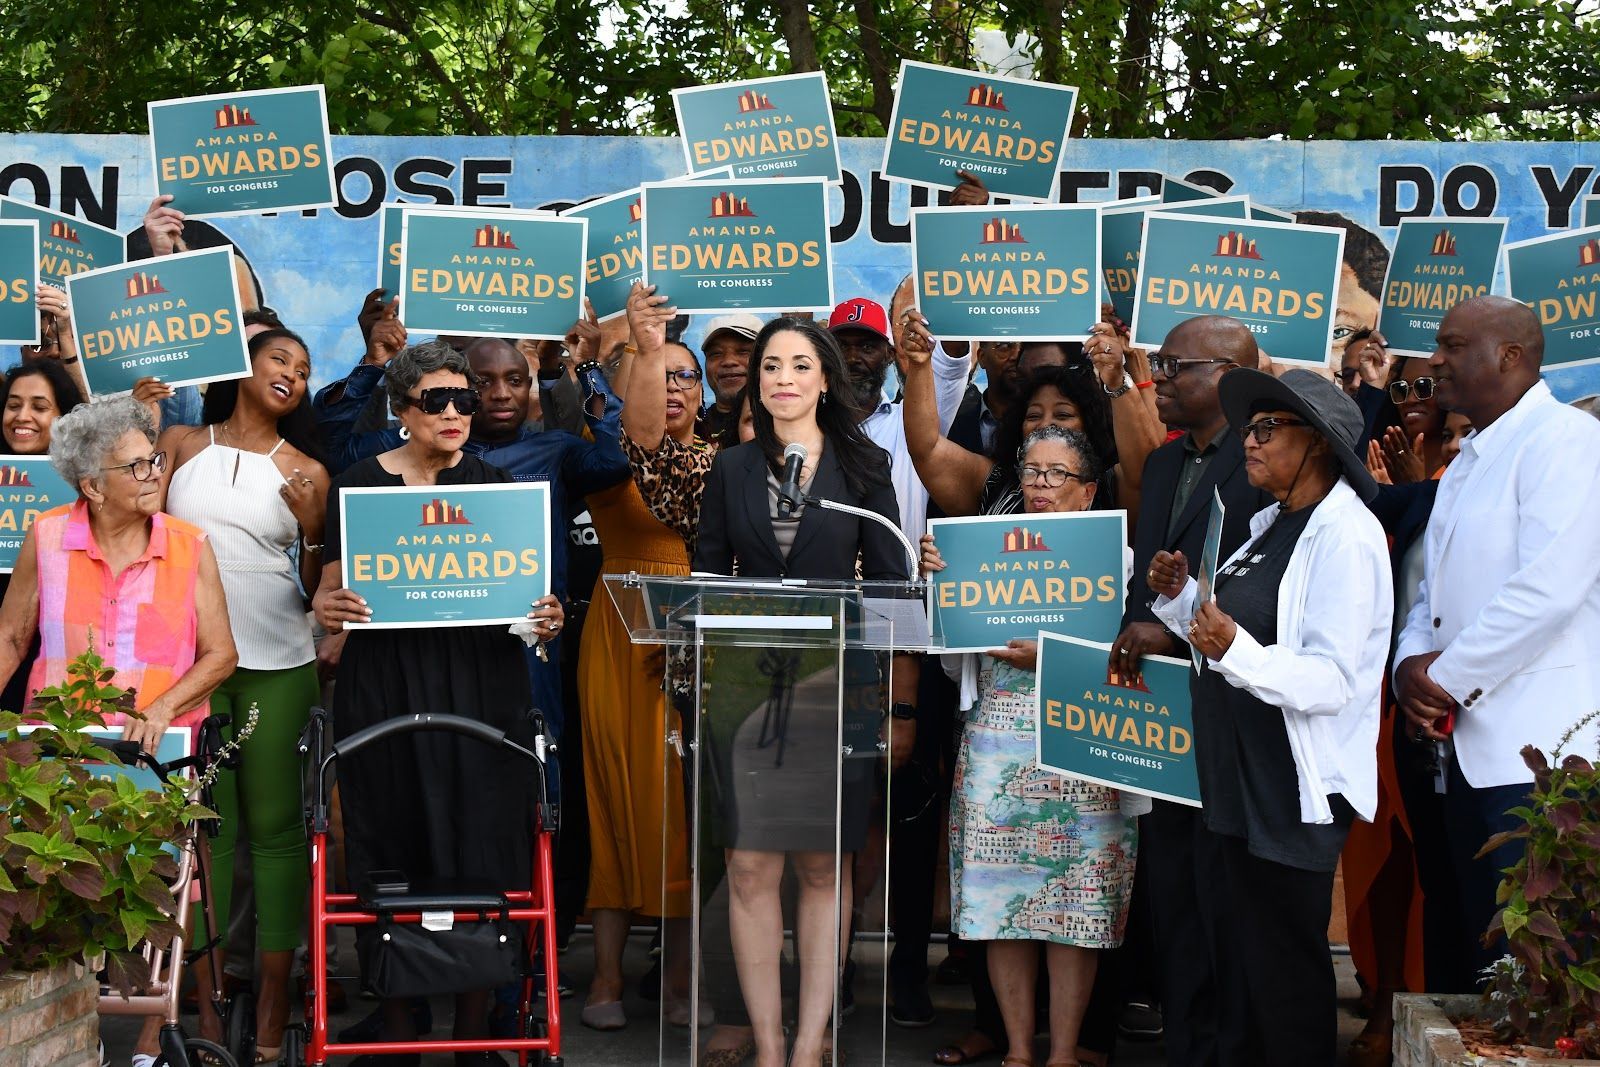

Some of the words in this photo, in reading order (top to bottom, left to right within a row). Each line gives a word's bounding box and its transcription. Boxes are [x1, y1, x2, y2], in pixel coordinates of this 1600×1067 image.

[724, 115, 793, 131] AMANDA
[940, 110, 1023, 130] AMANDA
[196, 131, 278, 147] AMANDA
[693, 125, 829, 164] EDWARDS
[899, 118, 1056, 164] EDWARDS
[161, 143, 321, 181] EDWARDS
[738, 165, 754, 175] FOR
[757, 160, 798, 173] CONGRESS
[939, 158, 958, 168] FOR
[960, 162, 1008, 175] CONGRESS
[207, 185, 227, 194] FOR
[229, 181, 279, 192] CONGRESS
[262, 157, 512, 218] OSE
[1380, 166, 1497, 227] DO
[1532, 166, 1600, 228] Y
[689, 225, 776, 237] AMANDA
[43, 240, 94, 261] MANDA
[652, 241, 820, 271] EDWARDS
[960, 251, 1046, 263] AMANDA
[451, 254, 535, 267] AMANDA
[1189, 263, 1281, 281] AMANDA
[1414, 265, 1465, 276] AMANDA
[411, 268, 574, 299] EDWARDS
[697, 280, 717, 288] FOR
[720, 278, 773, 287] CONGRESS
[923, 268, 1089, 296] EDWARDS
[1557, 271, 1600, 289] AMA
[1146, 277, 1324, 319] EDWARDS
[110, 299, 187, 321] AMANDA
[456, 303, 475, 312] FOR
[478, 304, 528, 314] CONGRESS
[847, 304, 864, 322] J
[968, 307, 987, 315] FOR
[989, 306, 1041, 315] CONGRESS
[82, 309, 233, 359] EDWARDS
[1409, 320, 1421, 329] FOR
[1423, 321, 1440, 330] CONG
[1570, 328, 1591, 339] FOR
[121, 360, 138, 369] FOR
[139, 351, 189, 366] CONGRESS
[396, 532, 493, 546] AMANDA
[354, 549, 539, 581] EDWARDS
[979, 559, 1070, 573] AMANDA
[406, 591, 428, 600] FOR
[431, 589, 489, 598] CONGRESS
[939, 575, 1116, 608] EDWARDS
[987, 616, 1007, 625] FOR
[1010, 614, 1065, 623] CONGRESS
[1083, 690, 1170, 717] AMANDA
[1046, 699, 1192, 754] EDWARD
[1089, 746, 1108, 759] FOR
[1111, 751, 1163, 770] CONGRESS
